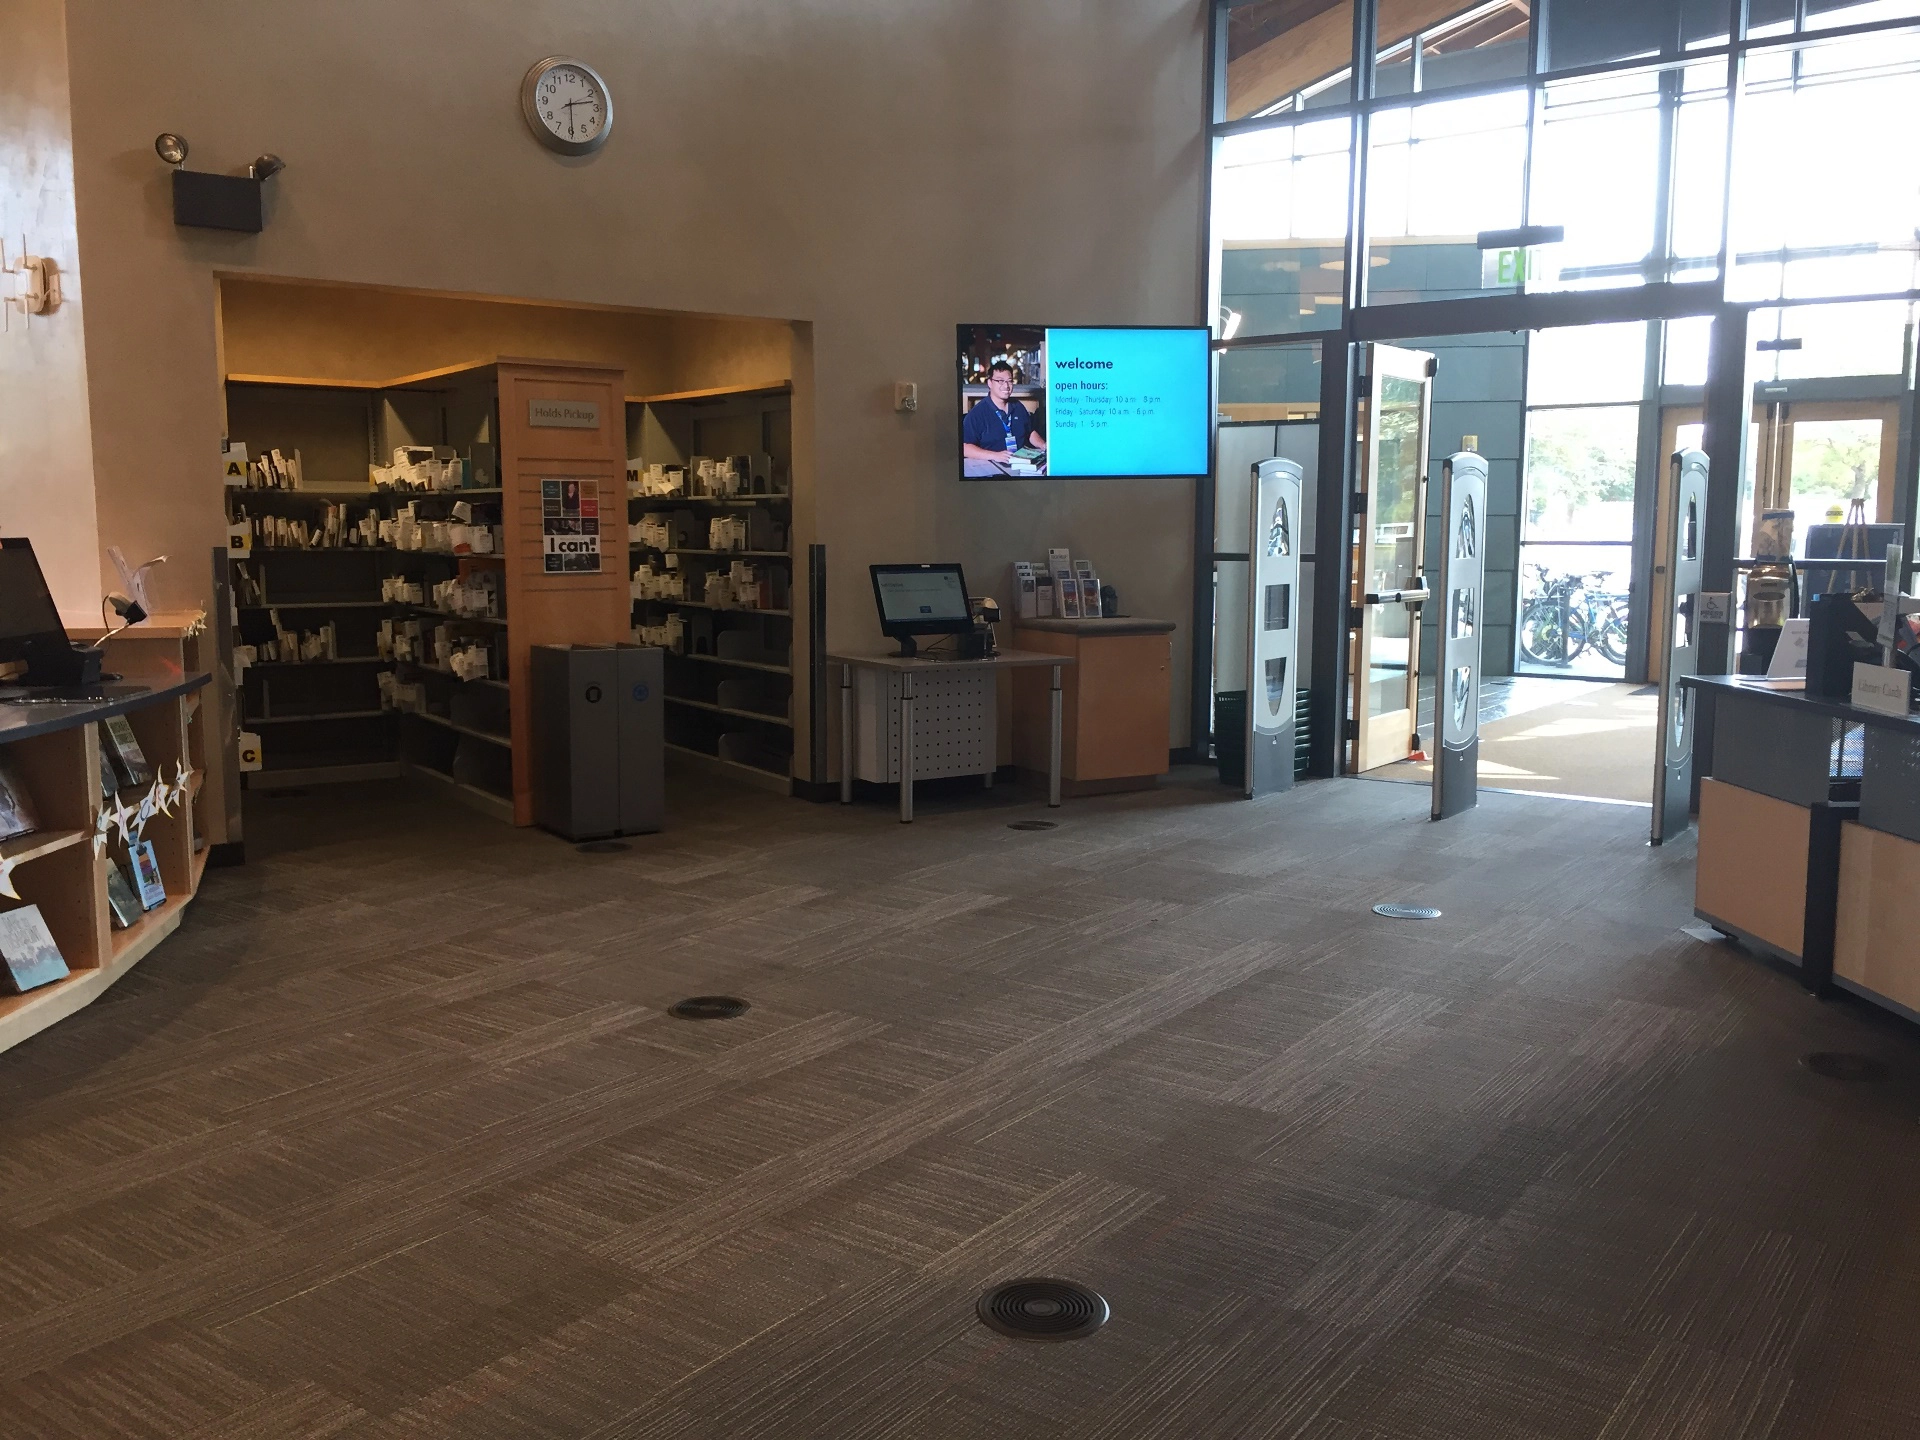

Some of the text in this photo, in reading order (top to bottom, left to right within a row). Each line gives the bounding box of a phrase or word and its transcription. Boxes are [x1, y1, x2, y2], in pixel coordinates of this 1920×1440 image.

[552, 76, 562, 84] 11
[564, 74, 576, 84] 12
[545, 84, 556, 94] 10
[588, 89, 594, 98] 2
[542, 96, 548, 105] 9
[593, 104, 600, 113] 3
[546, 110, 554, 120] 8
[590, 116, 596, 124] 4
[556, 122, 562, 130] 7
[568, 126, 574, 136] 6
[580, 124, 588, 134] 5
[1055, 357, 1114, 369] welcome
[1055, 380, 1108, 392] open hours:
[1055, 395, 1080, 405] Monday
[1115, 395, 1124, 403] 10
[535, 407, 594, 423] Holds Pickup
[1055, 407, 1074, 417] Friday
[1090, 420, 1094, 428] 5
[227, 462, 242, 476] A
[230, 535, 244, 549] B
[550, 537, 555, 552] I
[242, 748, 256, 763] C
